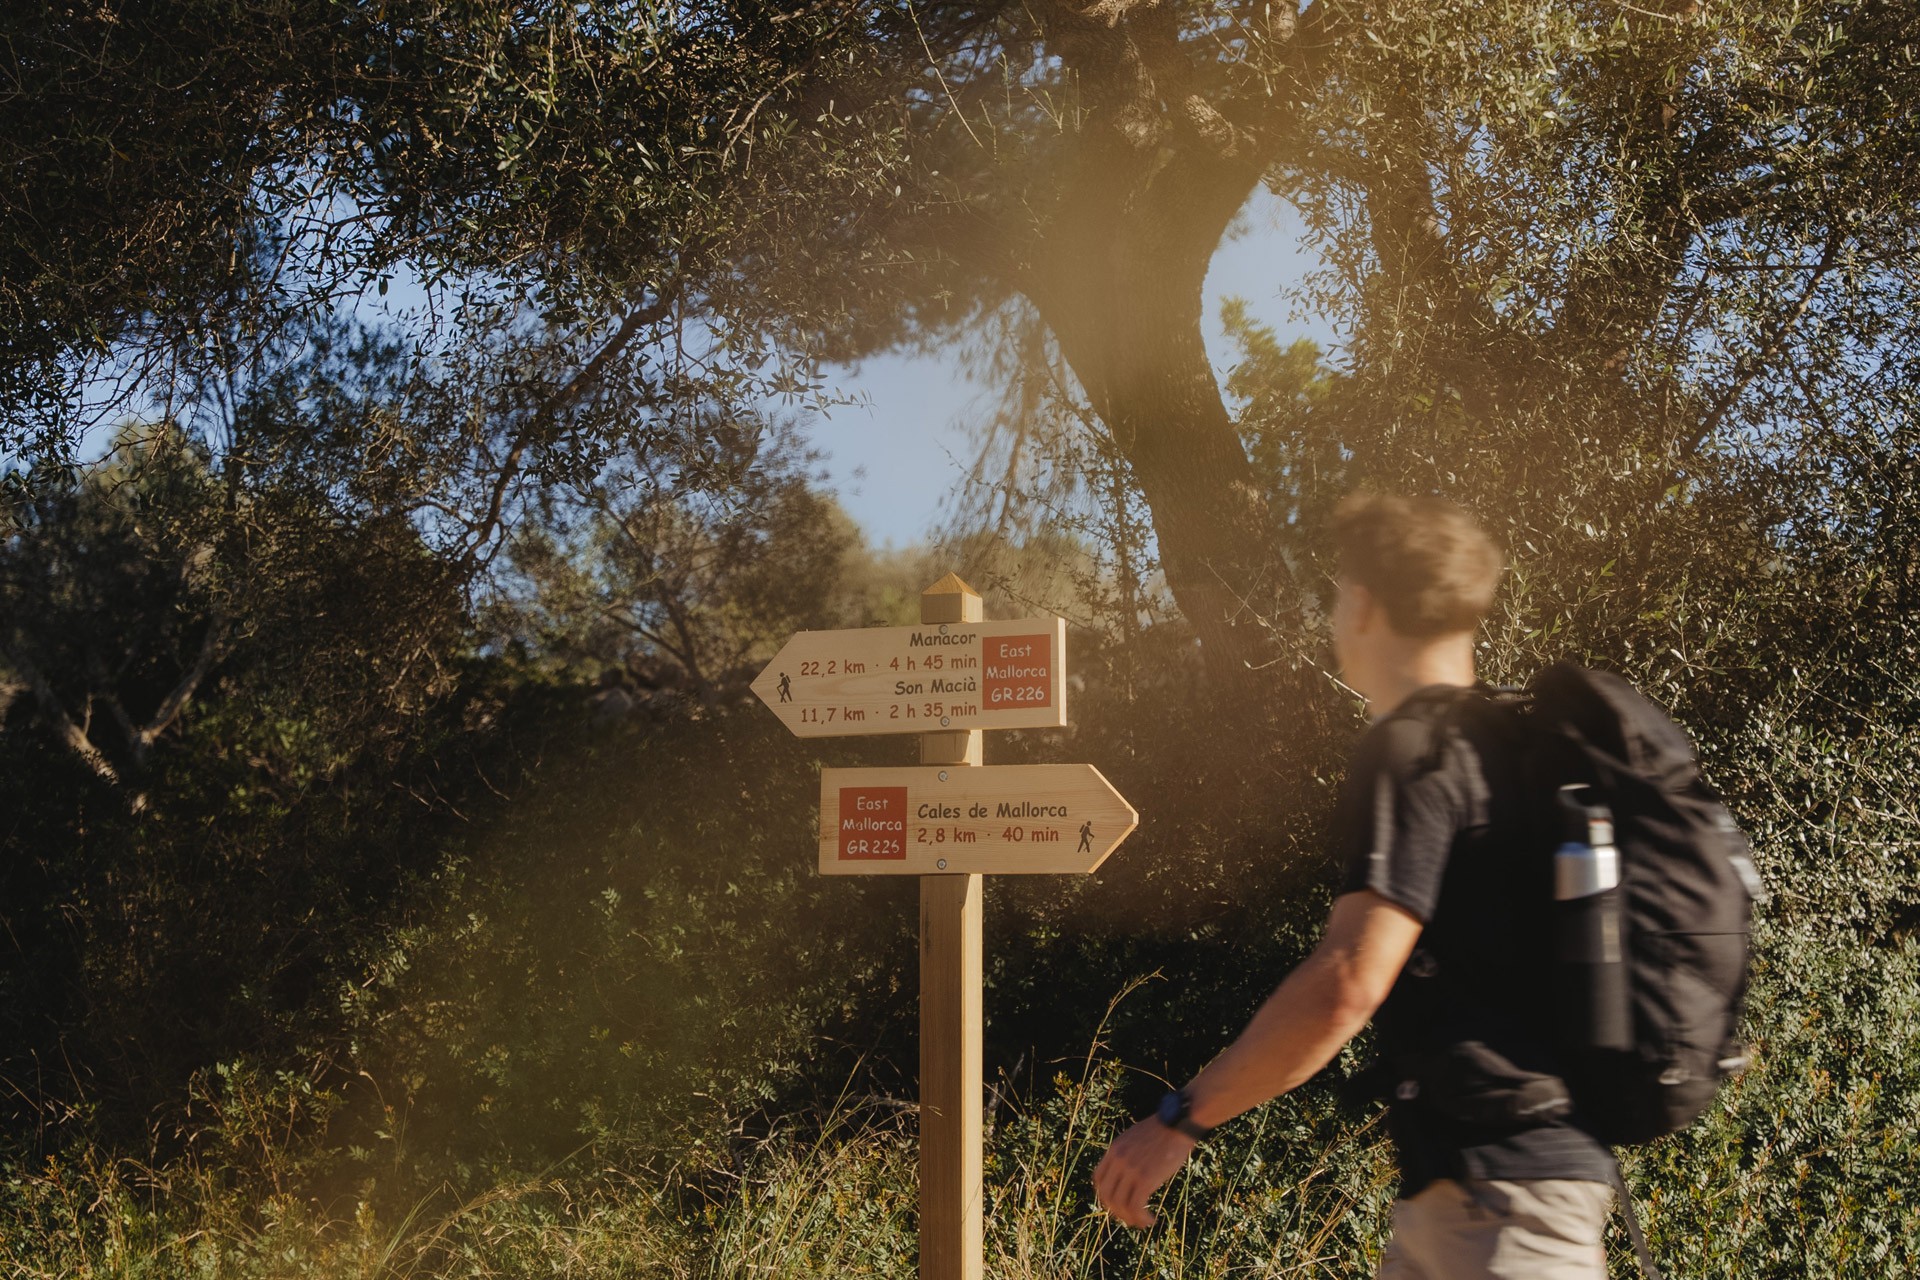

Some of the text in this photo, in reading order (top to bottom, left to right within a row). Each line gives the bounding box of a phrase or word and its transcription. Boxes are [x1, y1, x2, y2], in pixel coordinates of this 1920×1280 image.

[909, 632, 977, 647] Manacor
[1000, 644, 1032, 658] East
[801, 654, 977, 678] 22,2 km 4 h 45 min
[986, 665, 1047, 679] Mallorca
[894, 676, 977, 695] Son Macià
[991, 686, 1045, 702] GR 226
[801, 702, 977, 725] 11,7 km 2 h 35 min
[857, 796, 889, 811] East
[917, 801, 1067, 819] Cales de Mallorca
[842, 817, 903, 831] Mallorca
[917, 826, 1059, 846] 2,8 km 40 min
[846, 839, 869, 854] GR
